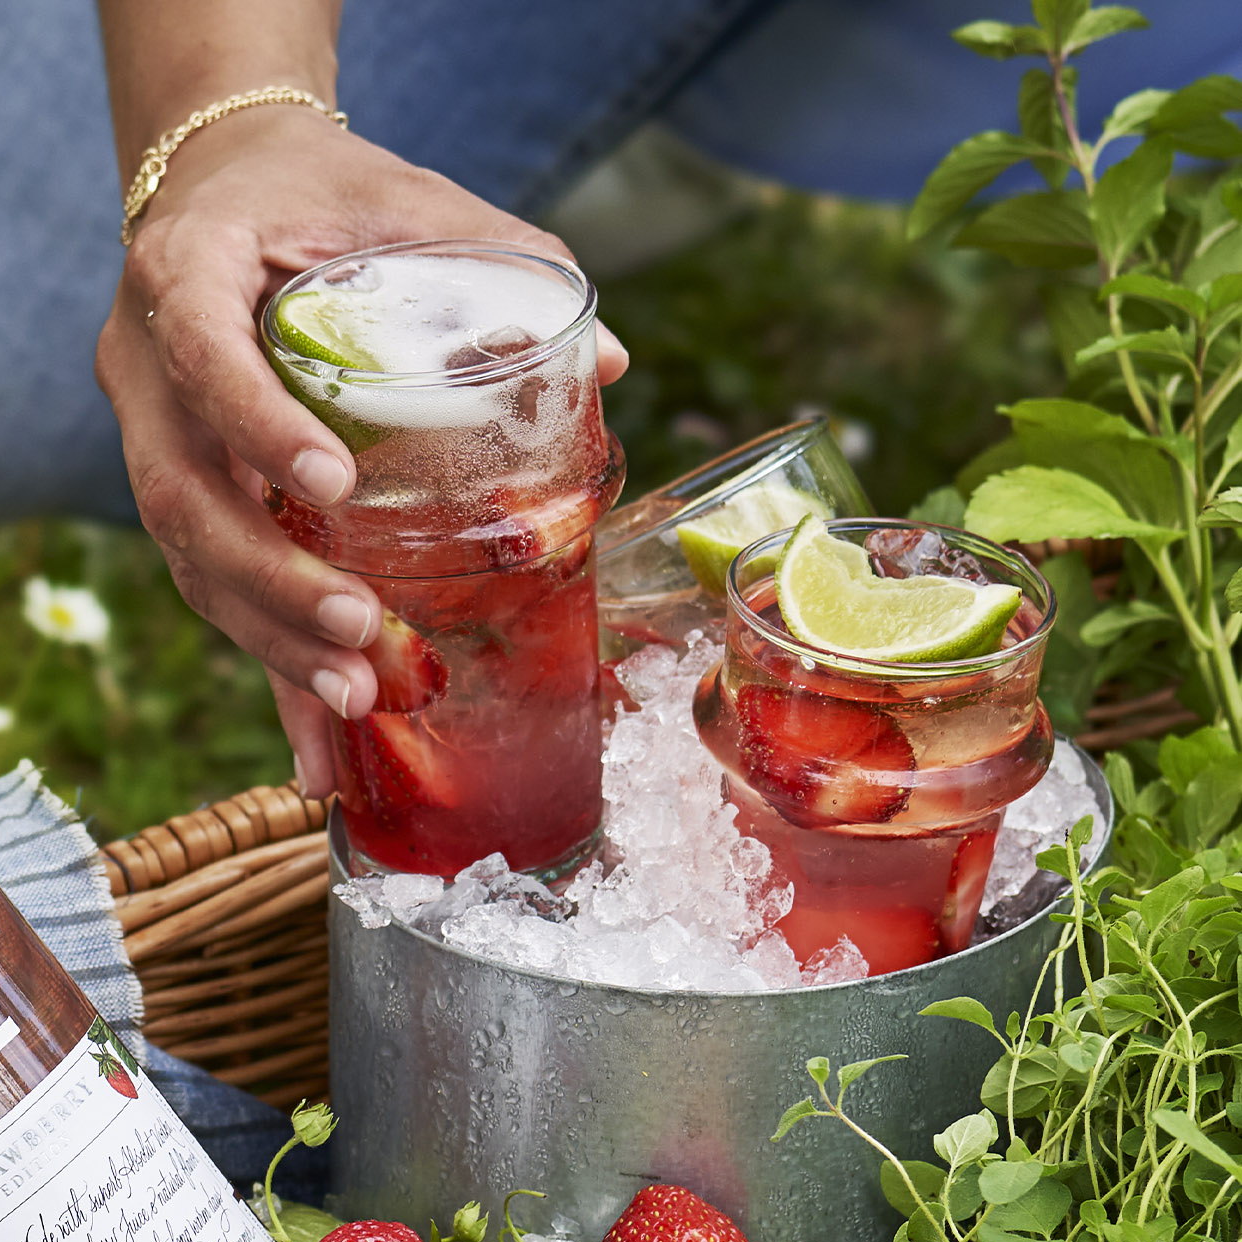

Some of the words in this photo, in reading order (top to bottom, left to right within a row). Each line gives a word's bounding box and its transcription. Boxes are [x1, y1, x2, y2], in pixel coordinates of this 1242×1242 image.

[0, 1134, 71, 1197] EDITION
[55, 1180, 87, 1239] with
[88, 1157, 123, 1231] superb
[119, 1129, 156, 1199] Absolut
[158, 1152, 186, 1206] natural
[186, 1206, 211, 1236] warm
